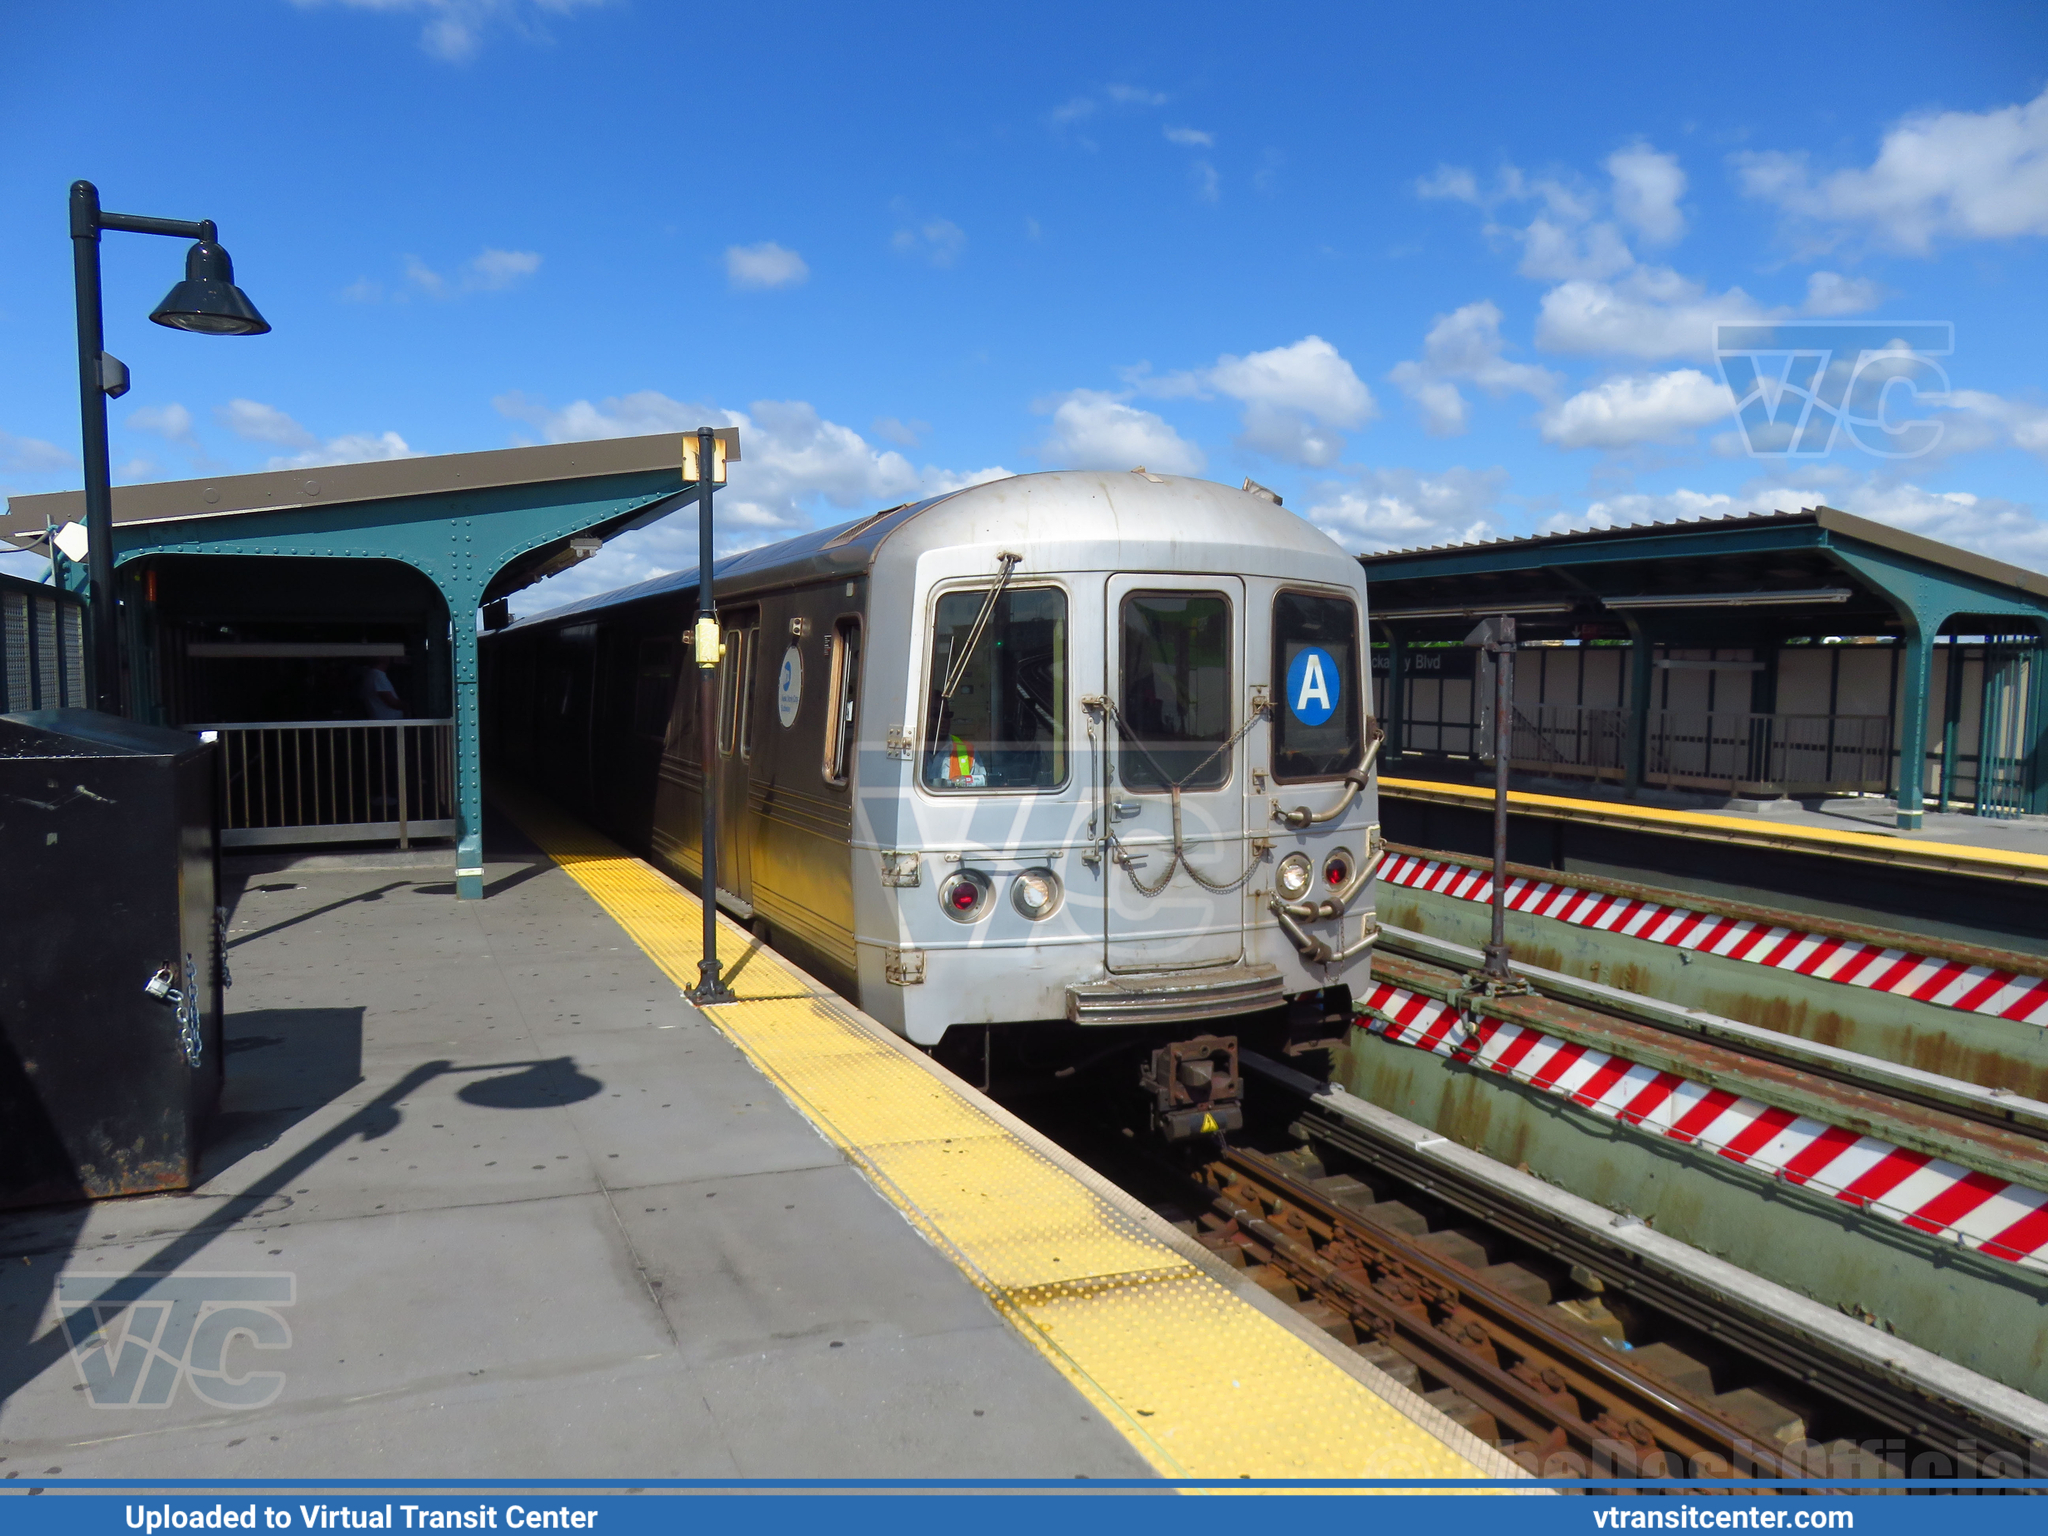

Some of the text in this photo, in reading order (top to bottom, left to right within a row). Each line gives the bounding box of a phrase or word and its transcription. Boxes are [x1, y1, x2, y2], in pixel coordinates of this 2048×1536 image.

[1371, 653, 1441, 672] ckay Blvd
[1296, 654, 1331, 710] A
